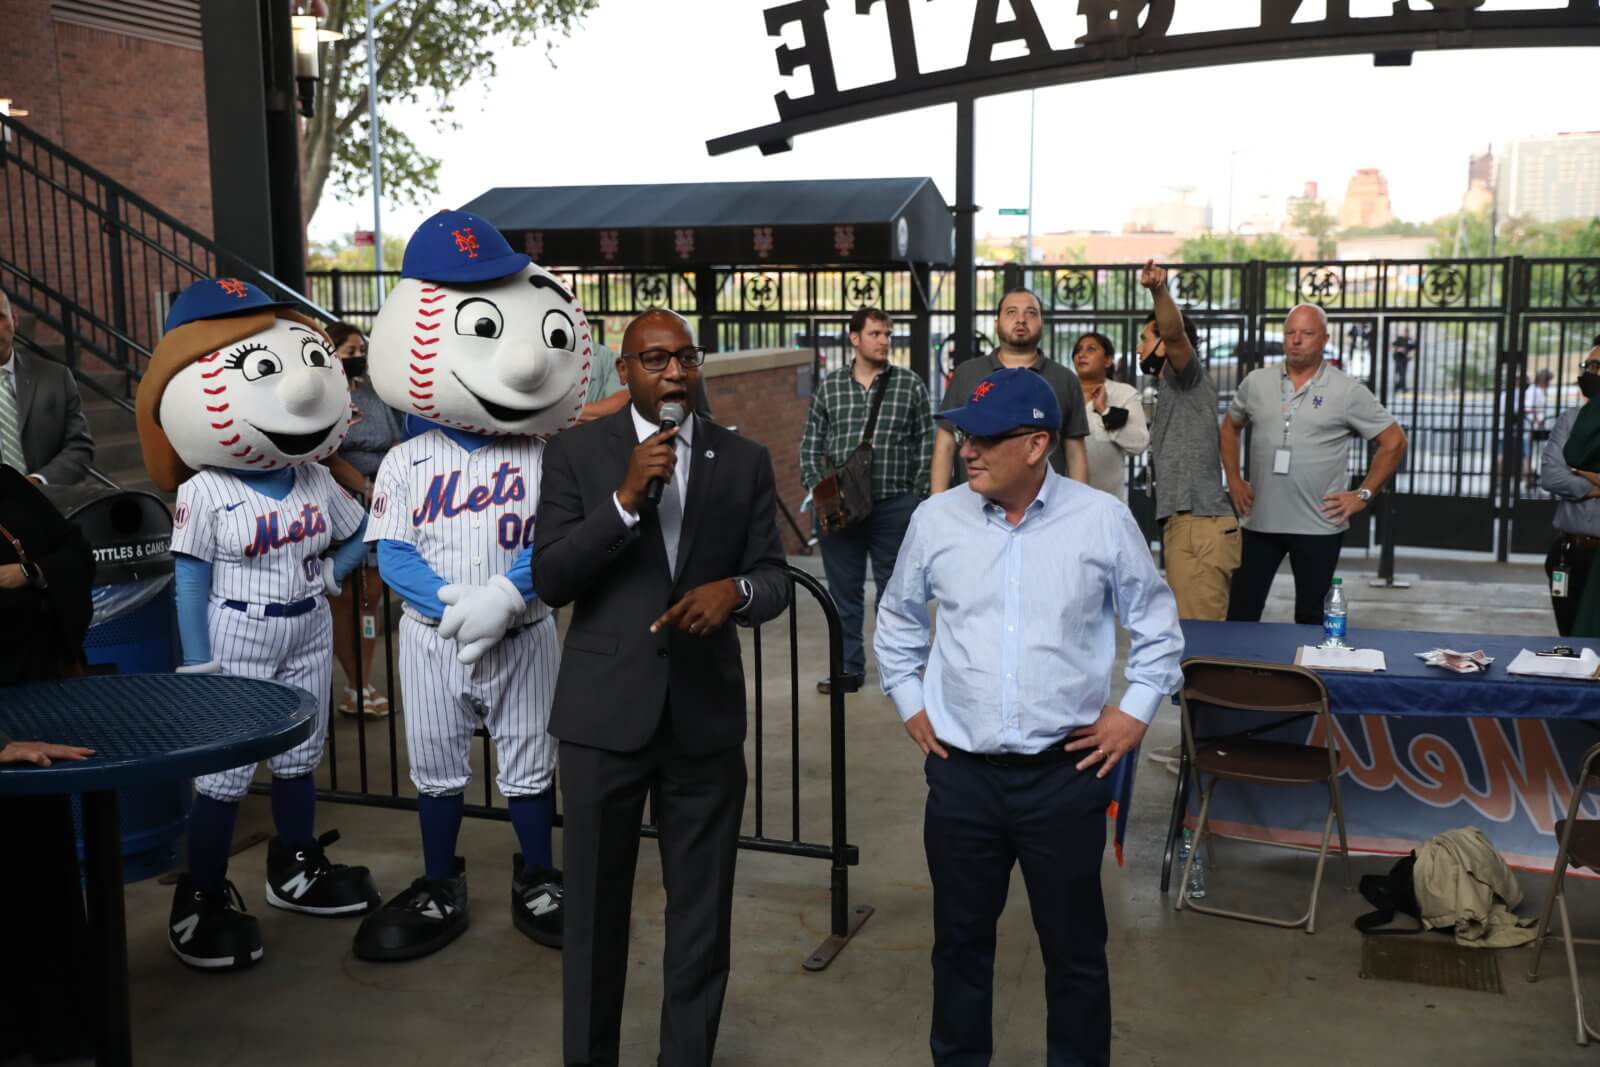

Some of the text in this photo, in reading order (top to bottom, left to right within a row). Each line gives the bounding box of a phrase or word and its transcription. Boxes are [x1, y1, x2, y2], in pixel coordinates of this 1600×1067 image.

[374, 498, 385, 513] 41
[412, 461, 526, 528] Mets
[244, 503, 327, 559] Mets
[92, 546, 134, 562] OTTLES
[136, 543, 144, 557] &
[145, 541, 165, 555] CANS
